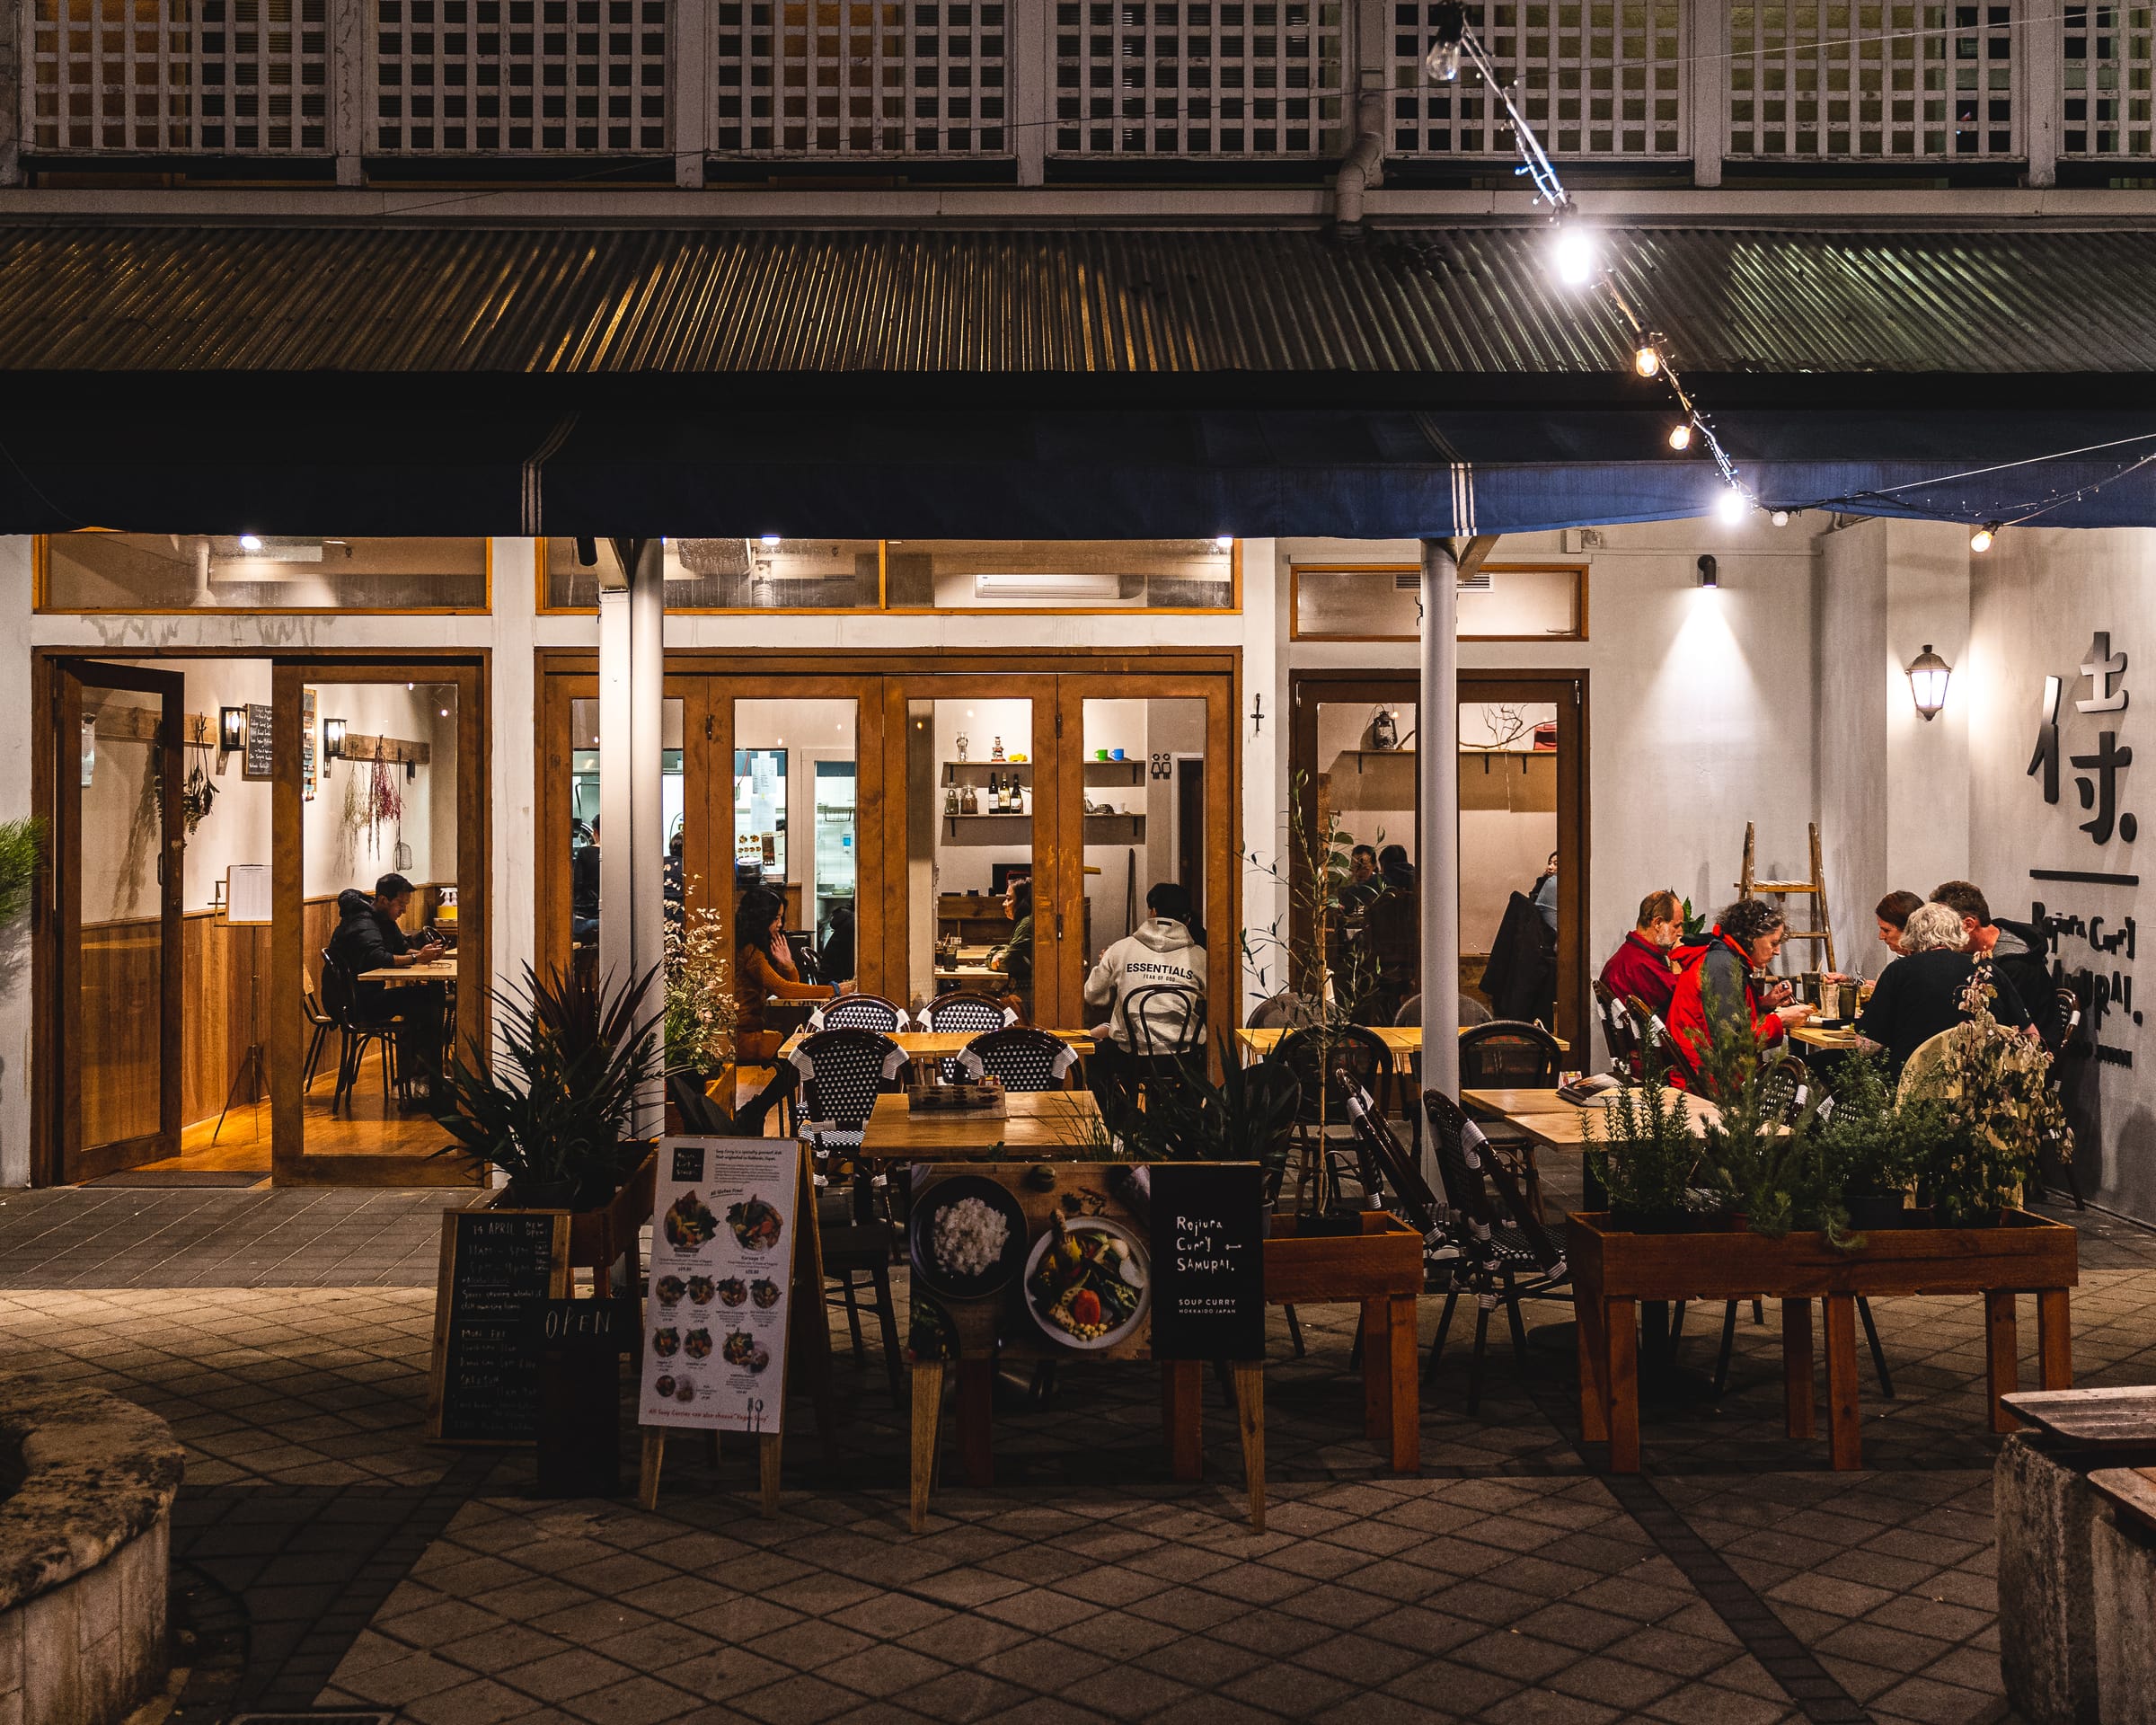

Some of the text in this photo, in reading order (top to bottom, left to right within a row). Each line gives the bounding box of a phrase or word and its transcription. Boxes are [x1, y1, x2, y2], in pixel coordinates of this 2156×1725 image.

[1127, 962, 1194, 980] ESSENTIALS
[1177, 1216, 1224, 1237] Rojiura
[1177, 1236, 1211, 1252] Curry
[1179, 1298, 1236, 1306] SOUP CURRY
[545, 1306, 611, 1339] OPEN
